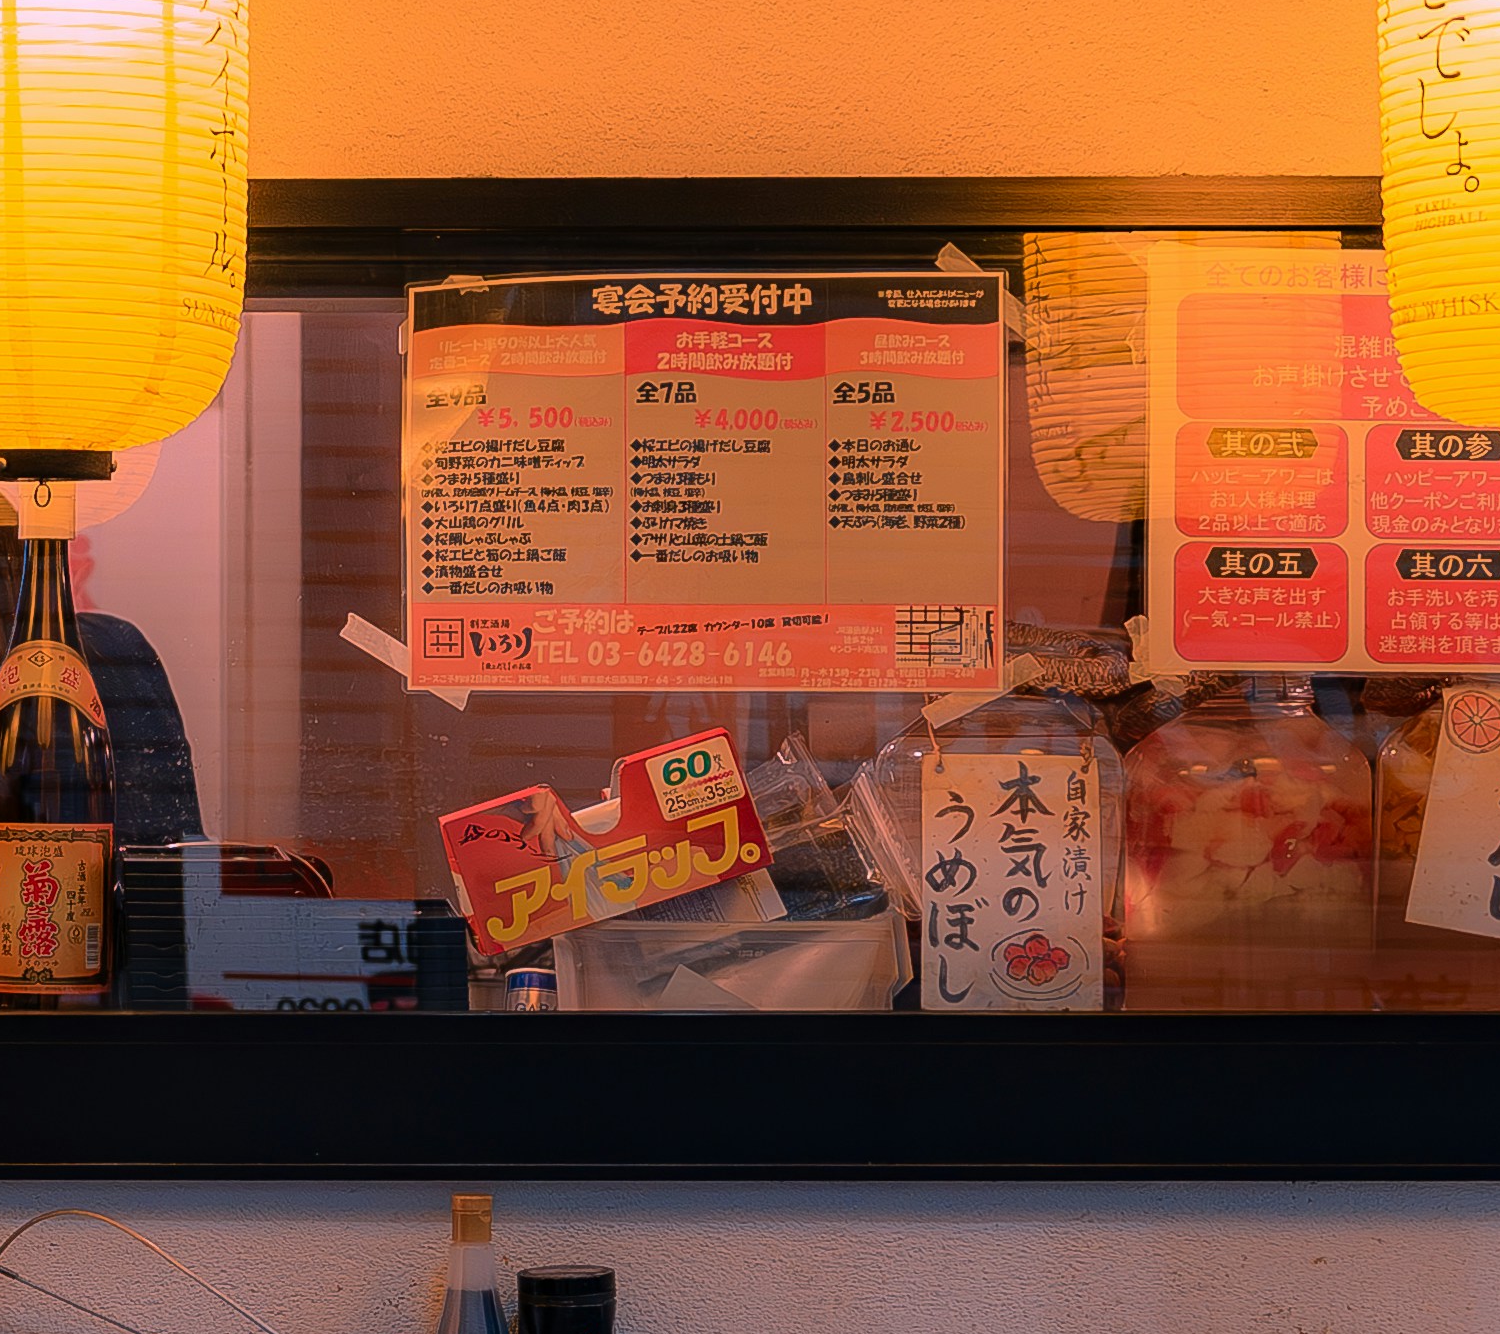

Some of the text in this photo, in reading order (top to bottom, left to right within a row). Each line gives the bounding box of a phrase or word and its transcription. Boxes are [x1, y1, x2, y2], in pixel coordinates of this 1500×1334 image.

[592, 283, 813, 315] 宴会予約受付中
[676, 332, 773, 349] お手軽コース
[874, 334, 951, 349] 昼飲みコース
[500, 350, 608, 366] 2時間飲み放題付
[657, 353, 794, 371] 2時間飲み放題付
[859, 350, 966, 366] 3時間飲み放題付
[425, 384, 488, 409] 全9品
[636, 381, 698, 405] 全7品
[833, 381, 896, 405] 全5品
[841, 438, 922, 453] 本日のお通し
[1220, 431, 1305, 458] 其の弐
[1411, 432, 1493, 461] 其の参
[642, 455, 702, 469] 明太サラダ
[841, 455, 910, 469] 明太サラダ
[1190, 468, 1336, 485] ハッピーアワーは
[1208, 490, 1317, 509] お1人様料理
[1197, 514, 1327, 533] 2品以上で適応
[1219, 550, 1303, 577] 其の五
[1410, 552, 1493, 579] 其の六
[1197, 586, 1327, 606] 大きな声を出す
[531, 608, 635, 635] ご予約は
[1182, 610, 1344, 629] (一気・コール禁止)
[469, 627, 533, 661] いろり
[533, 640, 793, 667] TEL 03-6428-6146
[662, 750, 712, 787] 60
[989, 760, 1057, 924] 本気の
[1062, 770, 1092, 916] 自家漬け
[924, 789, 990, 1005] うめぼし
